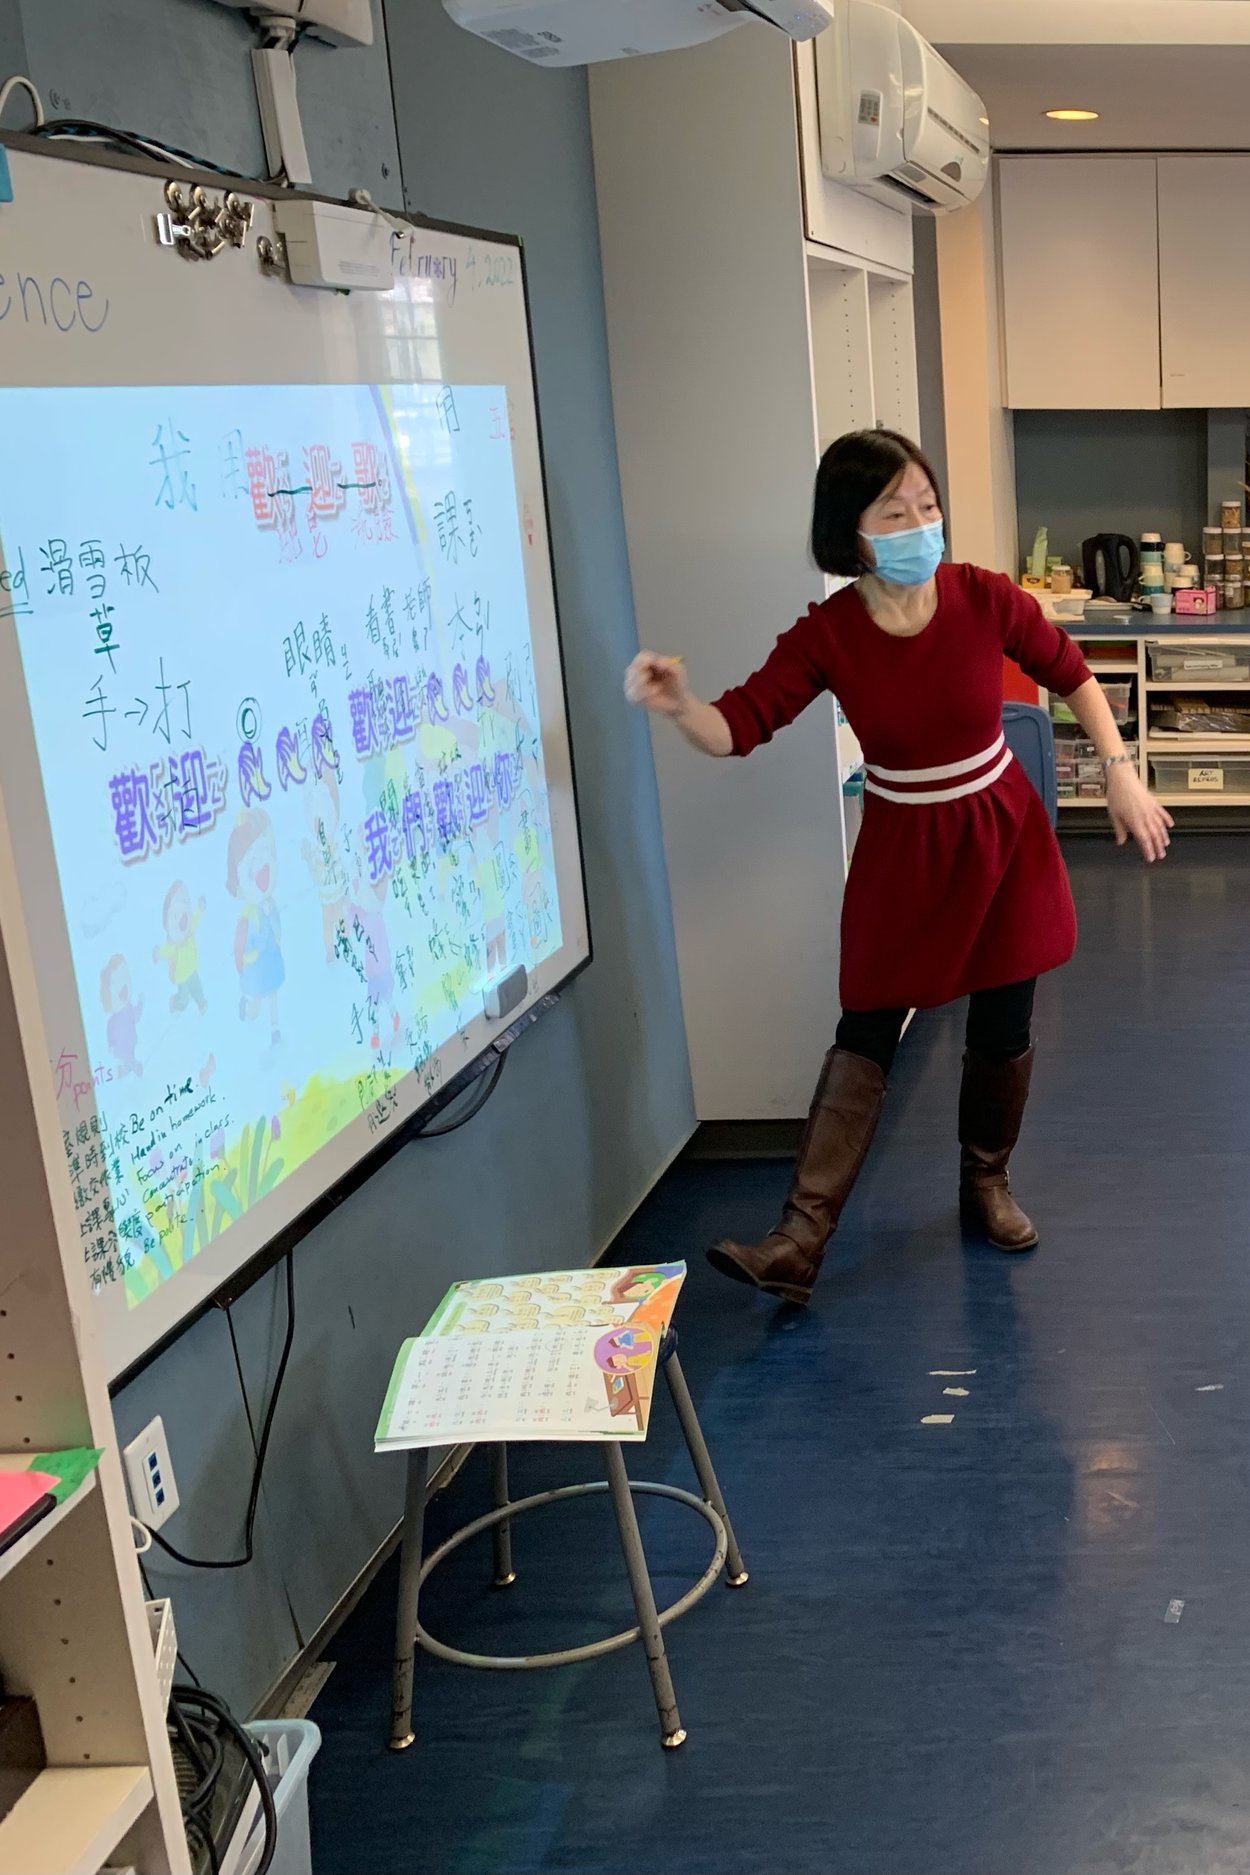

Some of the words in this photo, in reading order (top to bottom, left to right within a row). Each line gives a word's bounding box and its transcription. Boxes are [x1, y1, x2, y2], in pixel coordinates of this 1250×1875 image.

[148, 415, 199, 512] 我
[38, 538, 160, 600] 滑雪板
[282, 612, 337, 679] 眼睛
[82, 674, 118, 752] 手
[154, 656, 193, 743] 打
[57, 1047, 79, 1101] 分
[73, 1066, 114, 1113] points
[129, 1112, 146, 1135] Be
[150, 1105, 164, 1122] on
[130, 1130, 156, 1166] Hand
[168, 1143, 183, 1160] on
